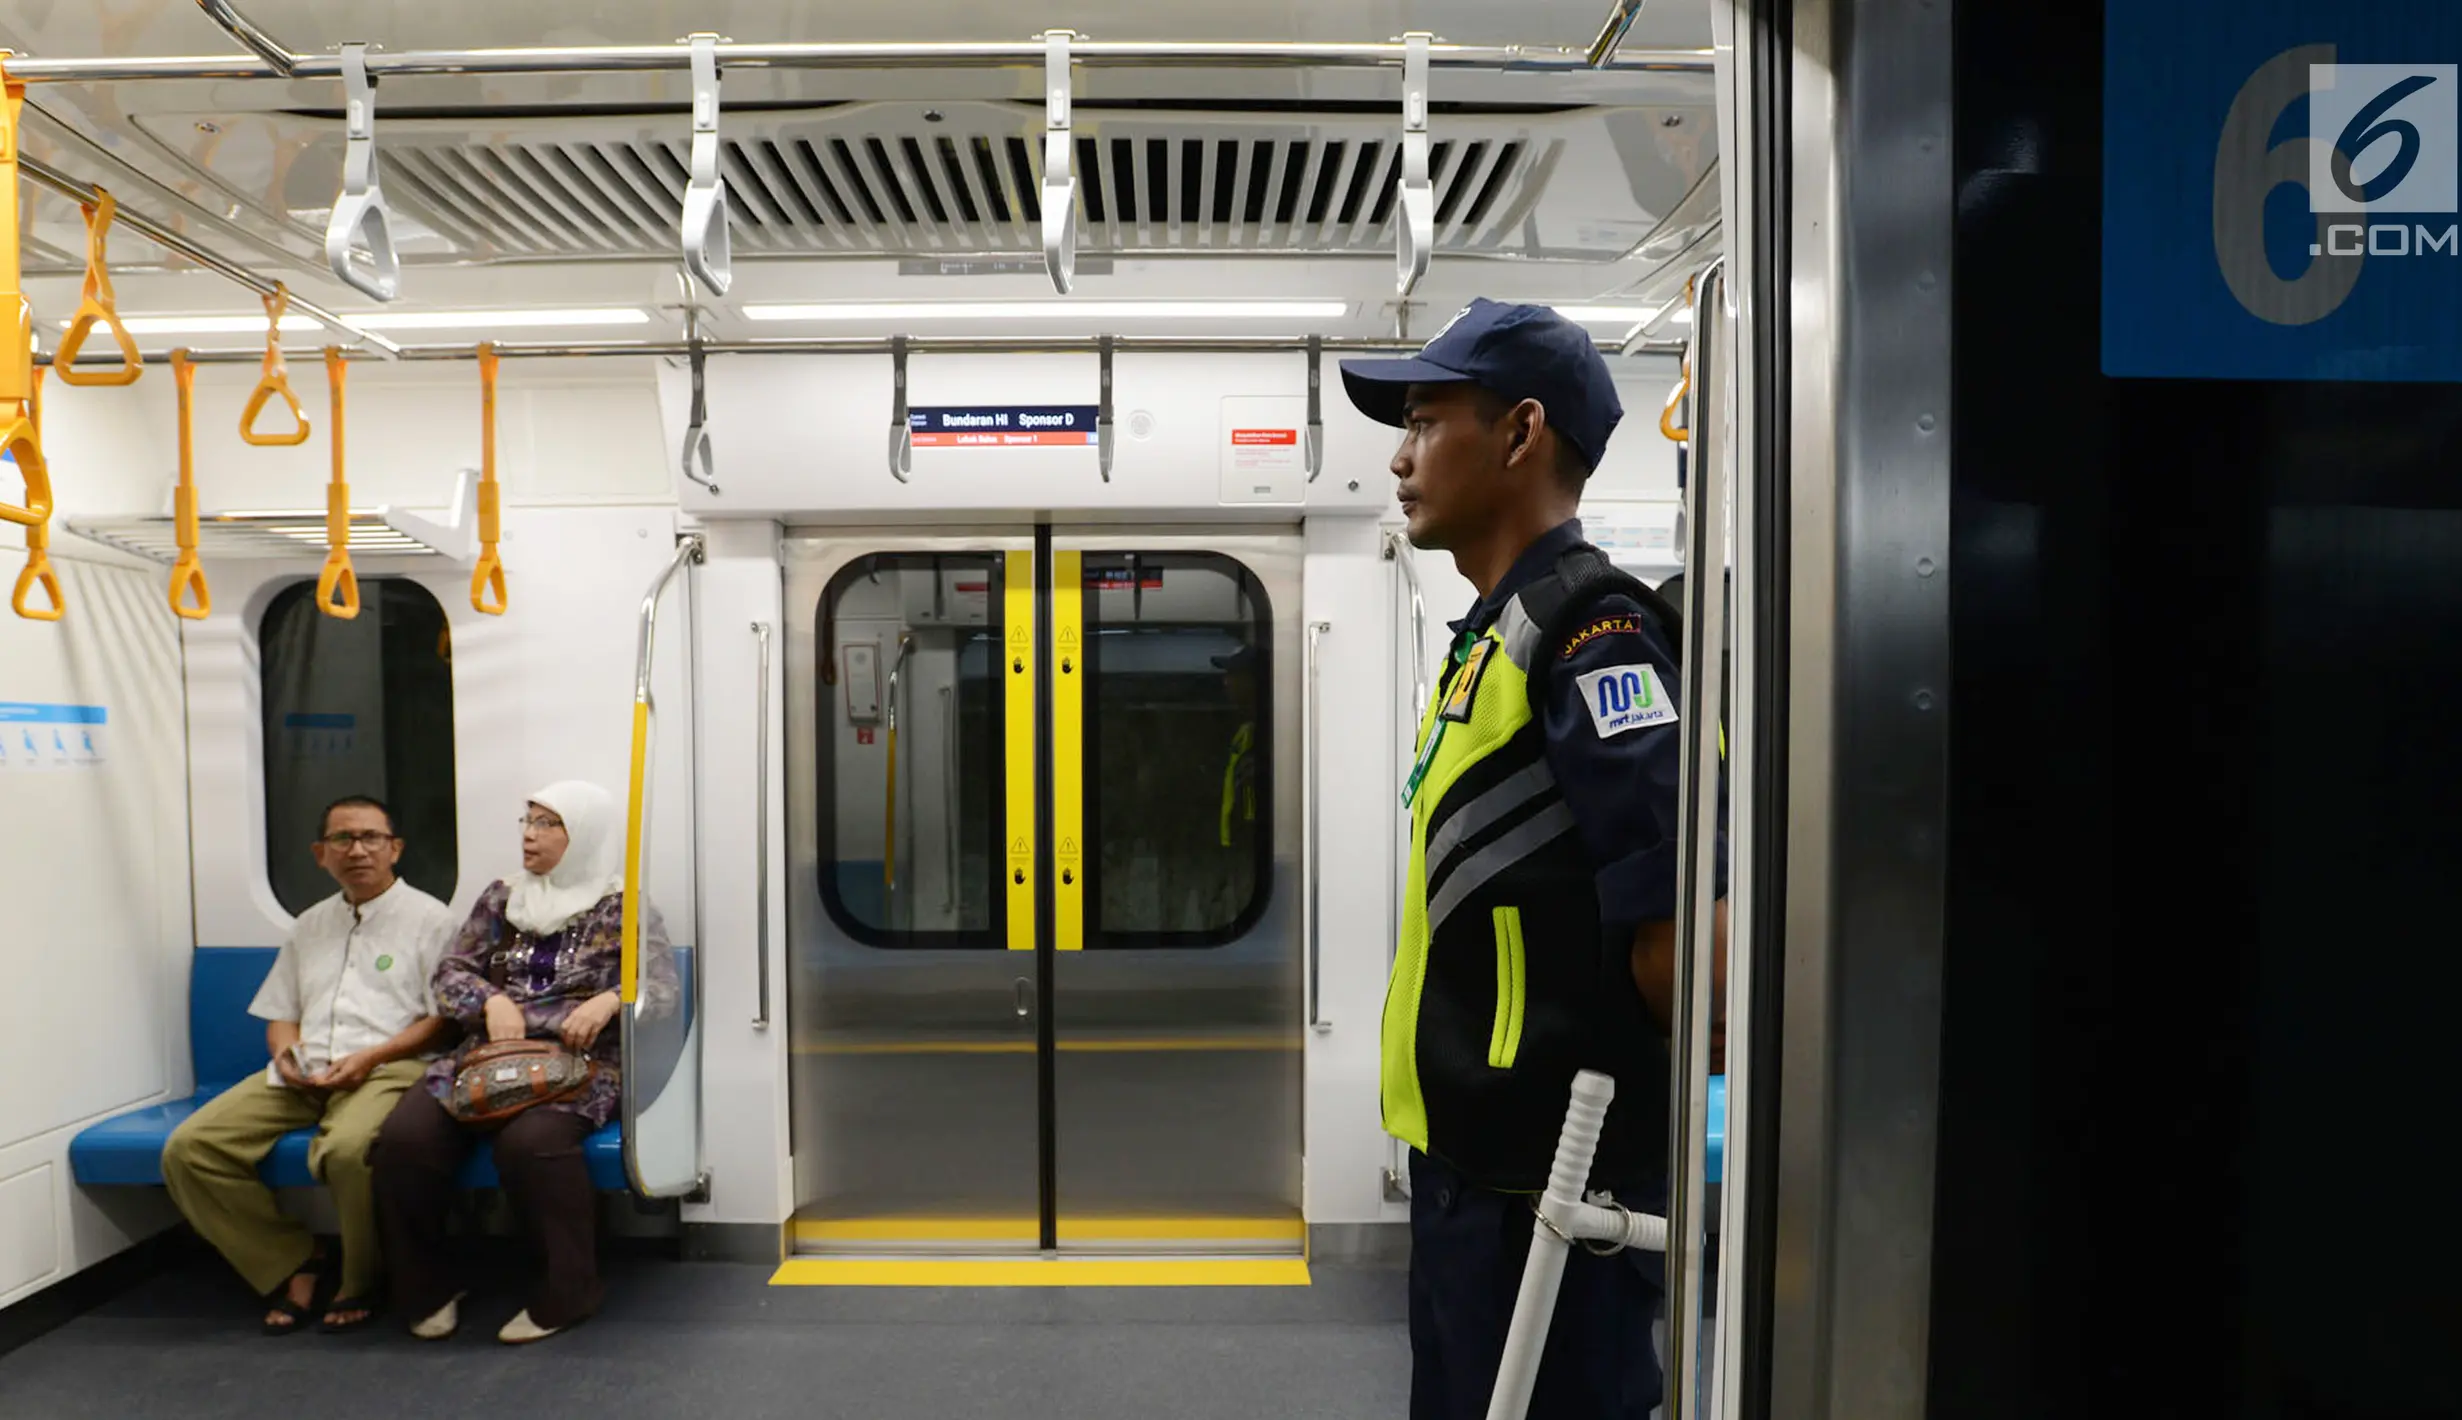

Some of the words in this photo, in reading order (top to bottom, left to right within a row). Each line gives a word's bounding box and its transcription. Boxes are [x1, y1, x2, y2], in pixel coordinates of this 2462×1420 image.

[2213, 42, 2367, 326] 6
[942, 413, 994, 427] Bundaran
[996, 413, 1008, 426] HI
[1019, 413, 1062, 428] Sponsor
[1065, 413, 1074, 426] D
[1565, 619, 1633, 654] JAKARTA
[1609, 715, 1630, 729] mrt
